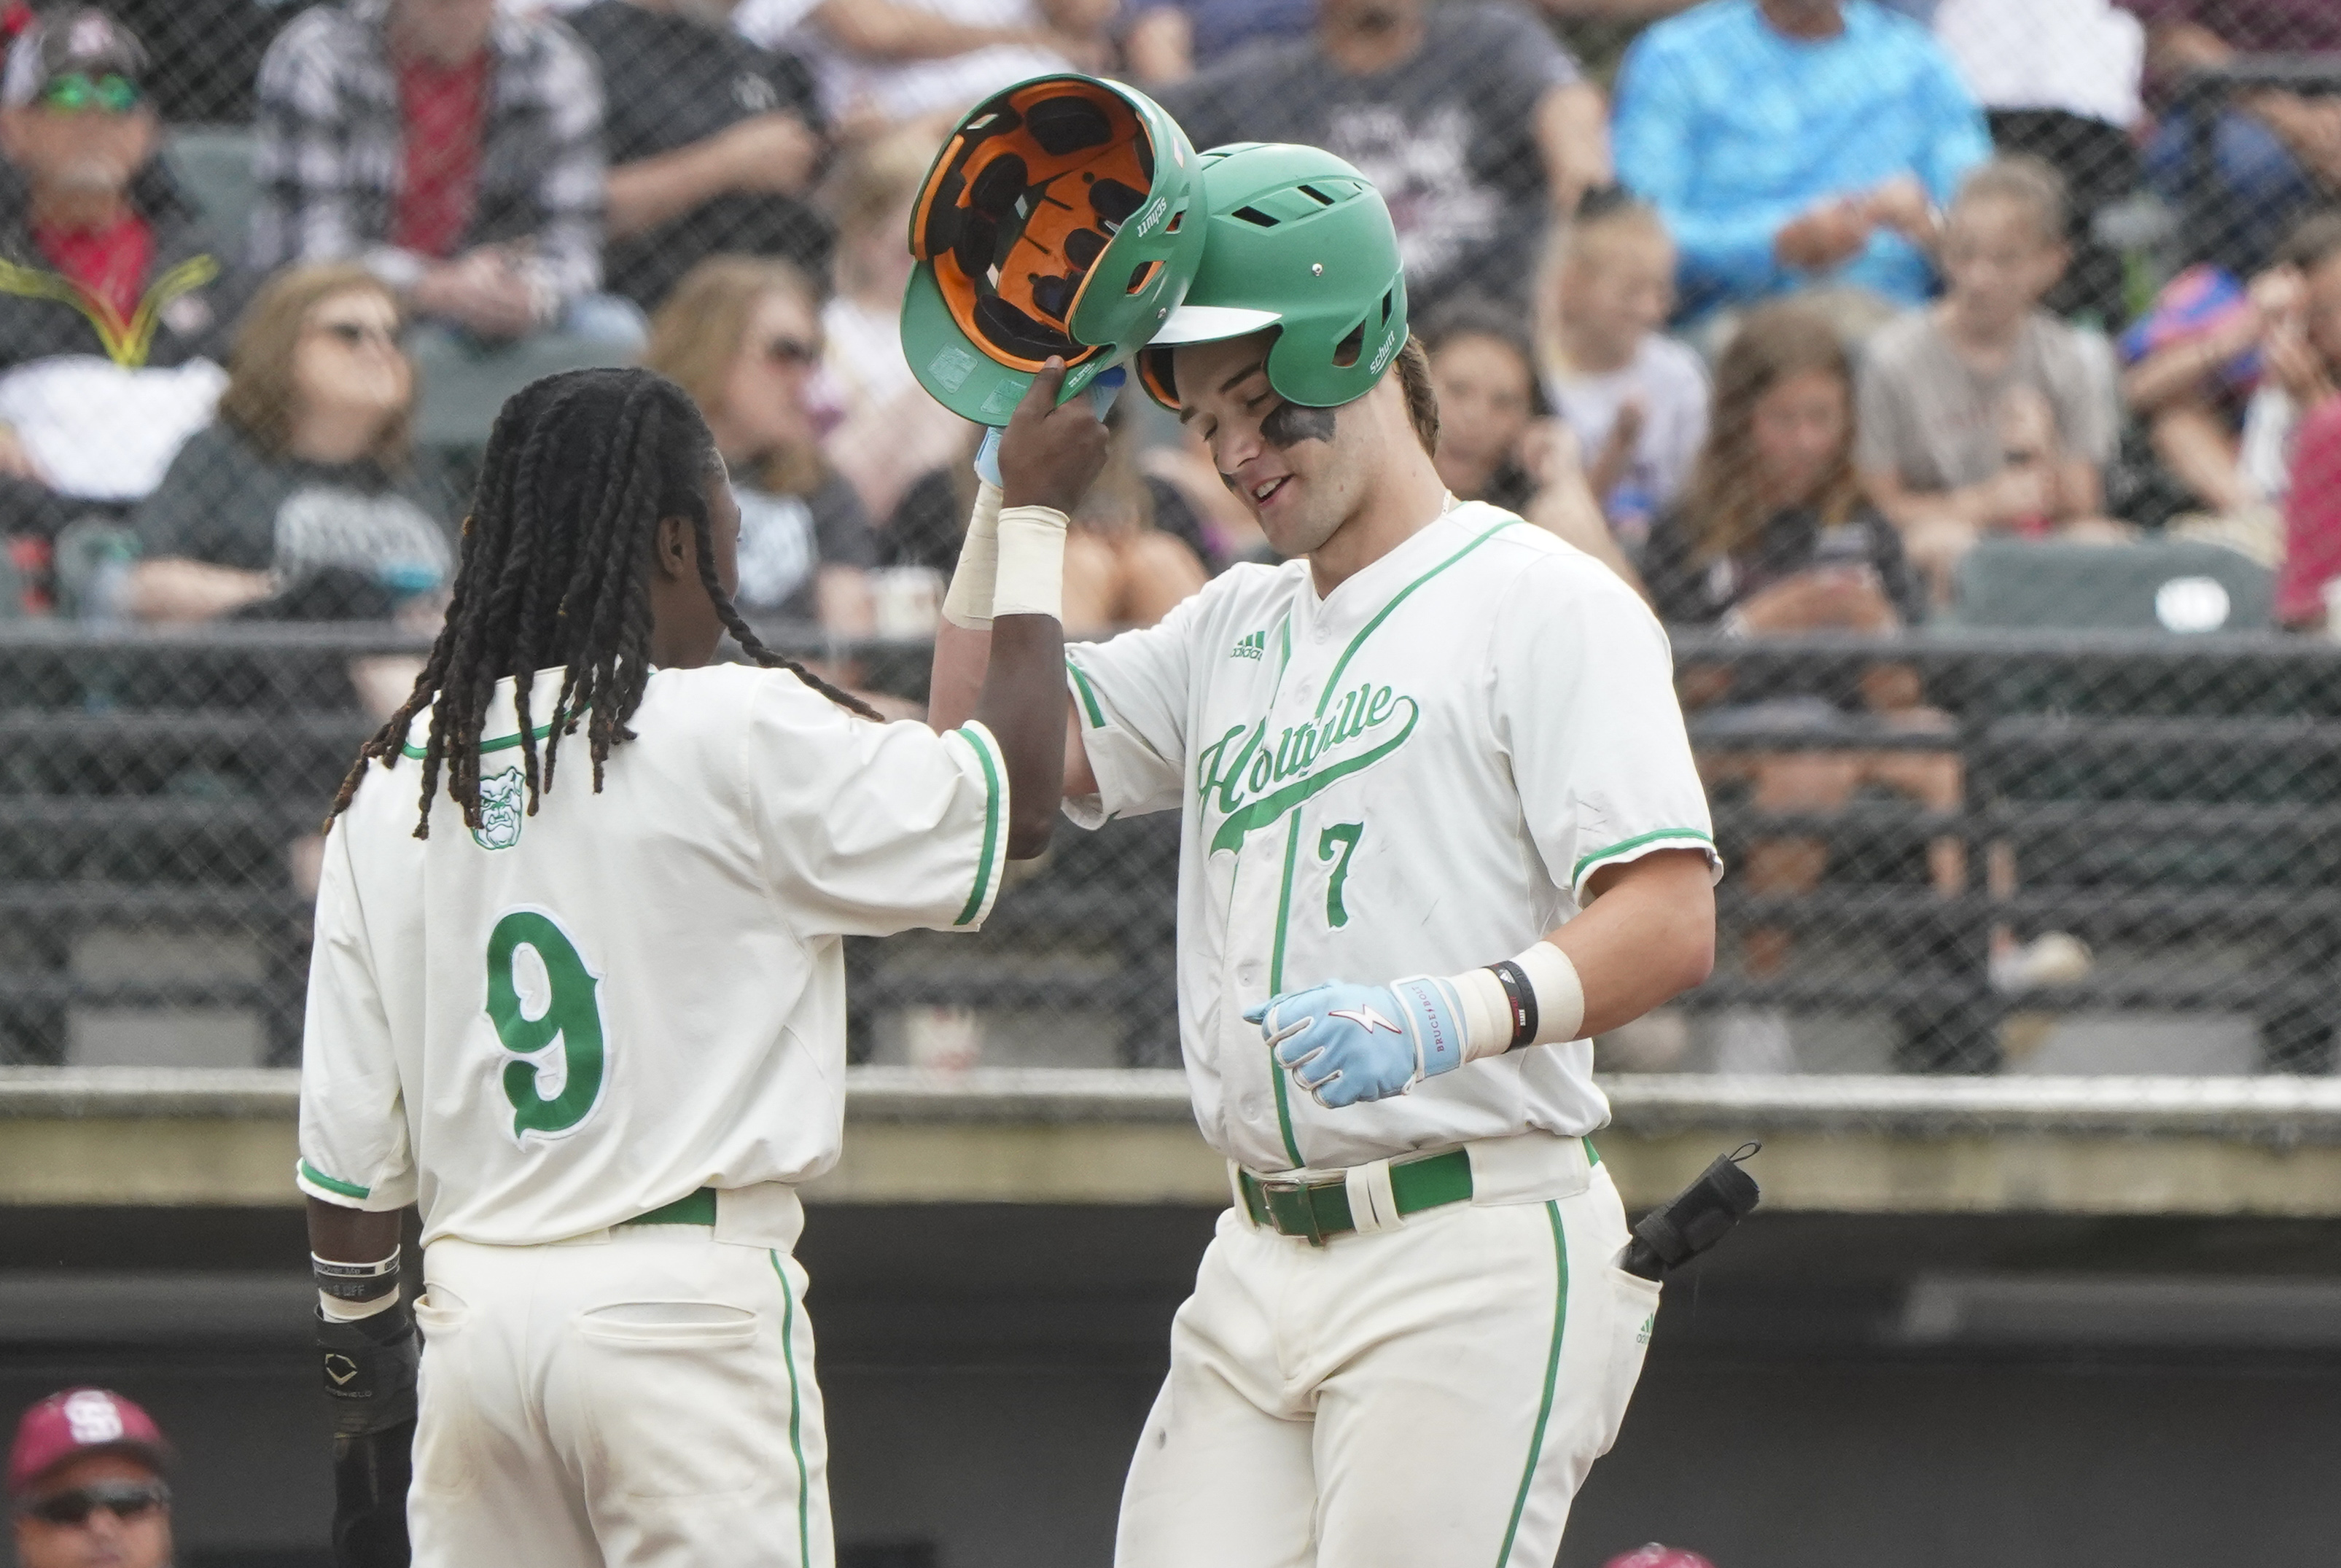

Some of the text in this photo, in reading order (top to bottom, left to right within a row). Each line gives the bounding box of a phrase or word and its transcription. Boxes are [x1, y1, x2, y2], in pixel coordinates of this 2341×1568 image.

[1369, 329, 1395, 375] schutt
[1317, 819, 1365, 930] 7
[483, 908, 606, 1143] 9
[1428, 1013, 1445, 1053] BRUCE
